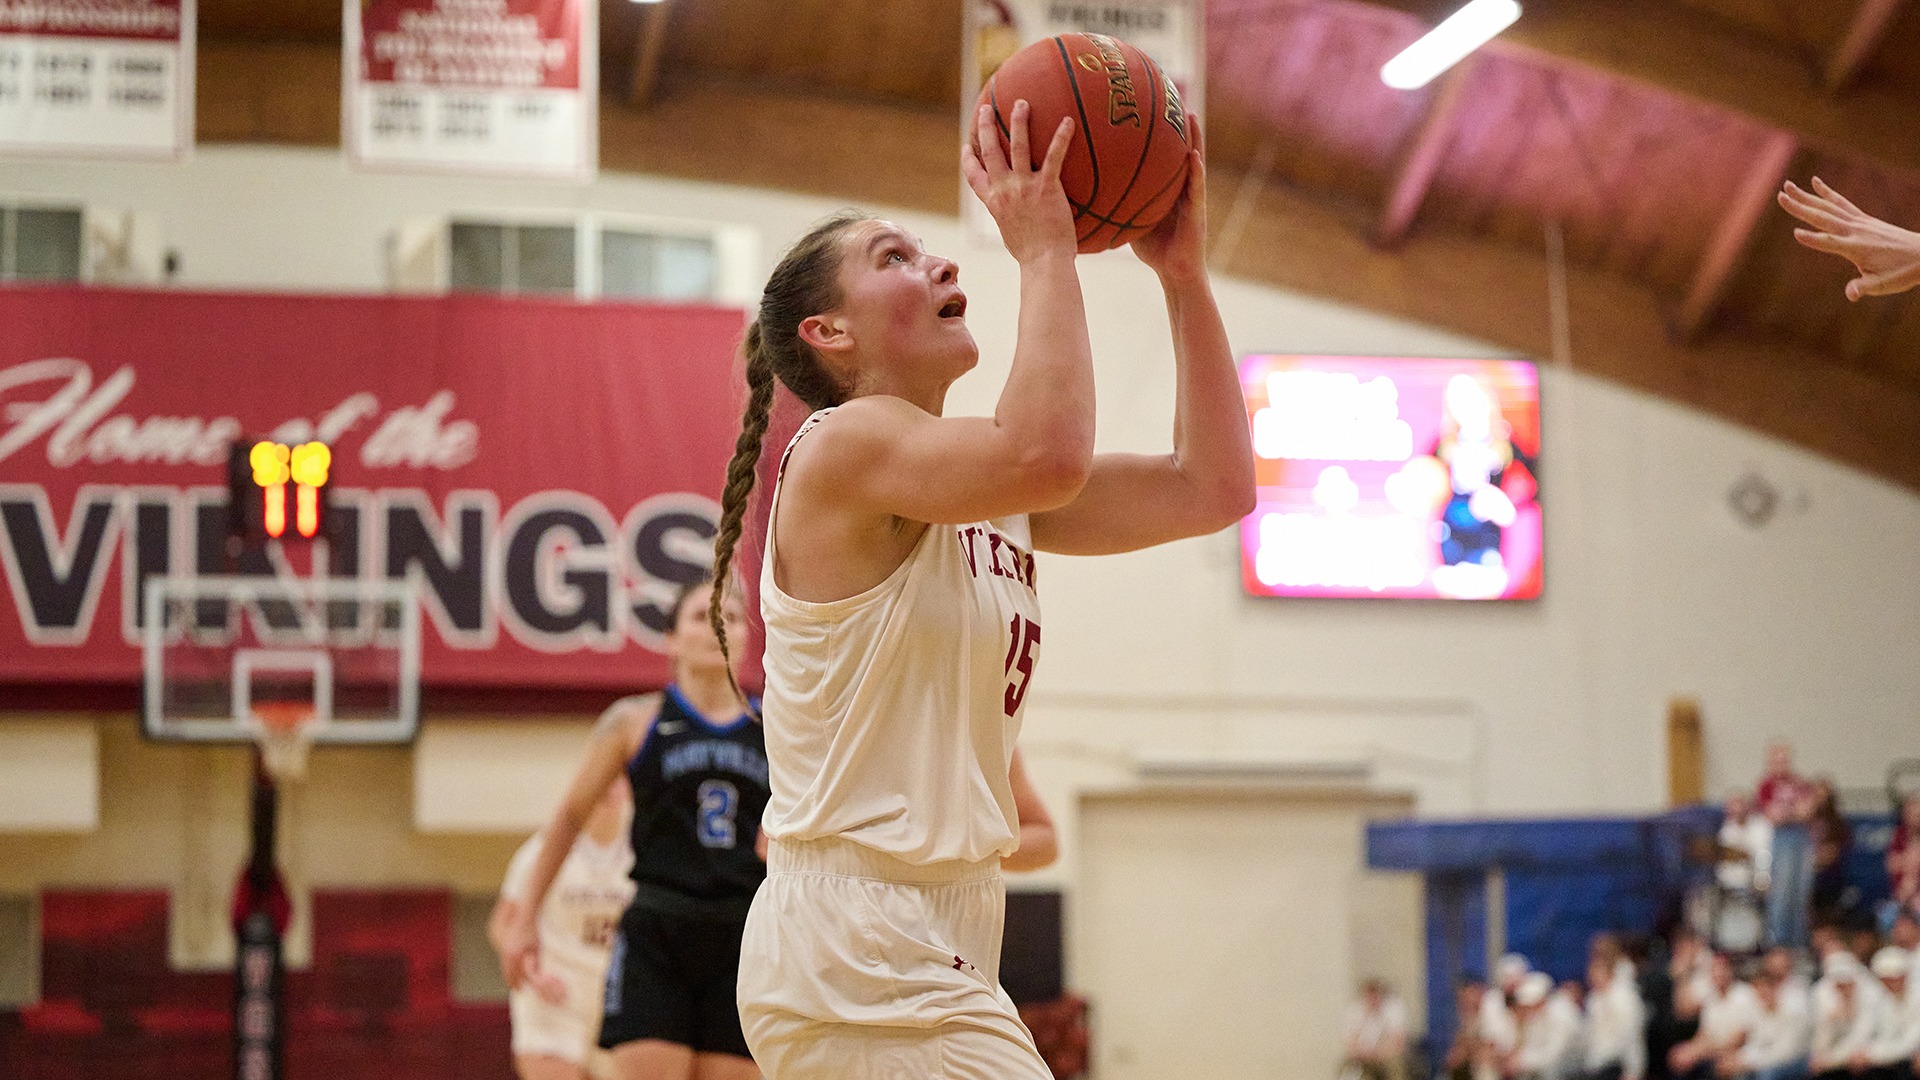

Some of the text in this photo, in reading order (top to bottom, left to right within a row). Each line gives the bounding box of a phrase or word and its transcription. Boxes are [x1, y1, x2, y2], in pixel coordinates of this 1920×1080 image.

[1081, 32, 1141, 128] SPALD
[359, 388, 480, 470] the
[1004, 612, 1041, 718] 15
[697, 779, 740, 849] 2
